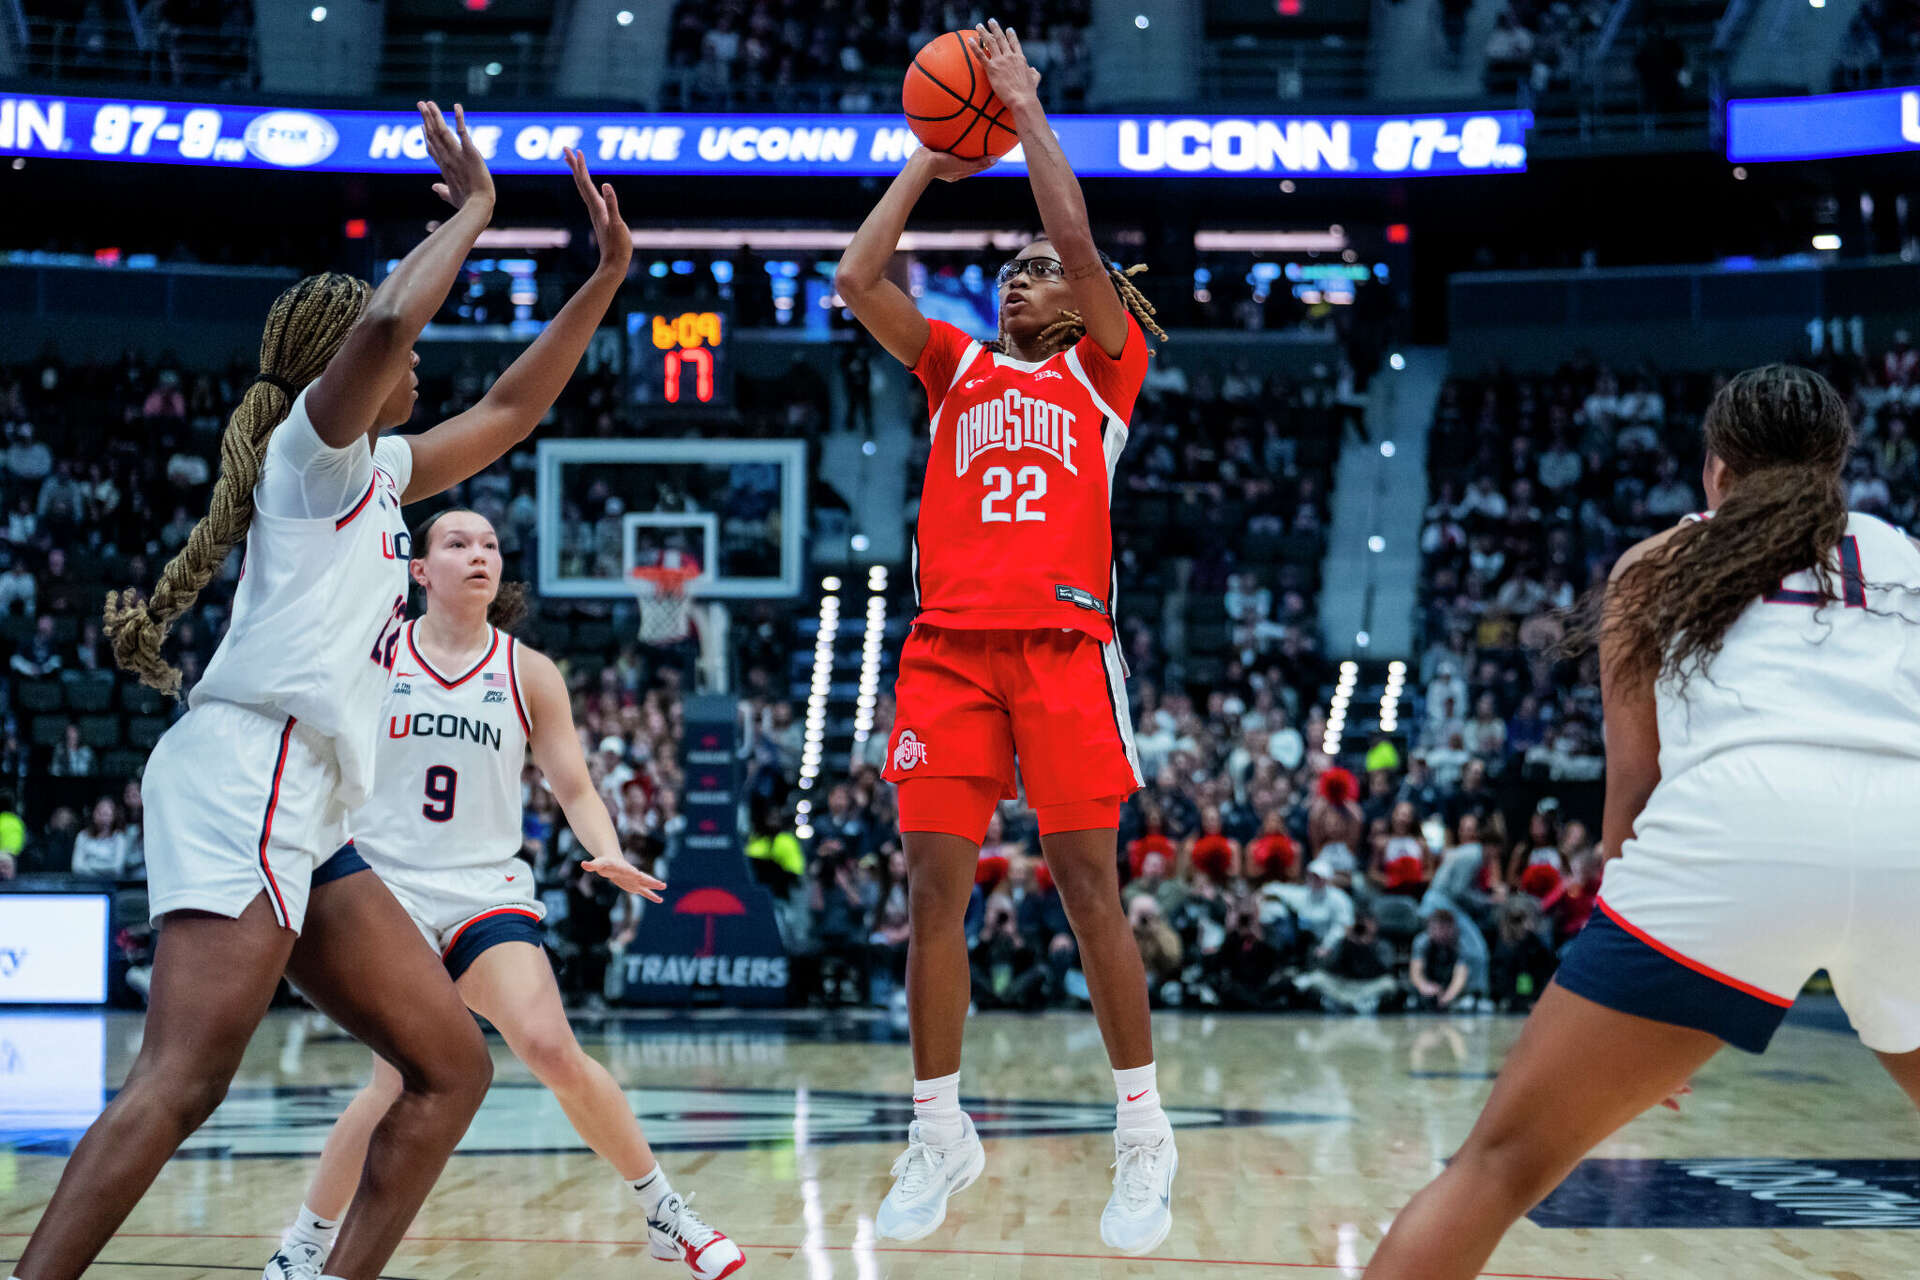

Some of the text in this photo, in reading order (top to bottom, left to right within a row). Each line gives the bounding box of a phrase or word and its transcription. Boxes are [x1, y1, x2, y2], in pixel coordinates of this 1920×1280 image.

[515, 125, 583, 160] OF
[597, 126, 685, 161] THE
[698, 127, 858, 162] UCONN
[1118, 119, 1351, 172] UCONN
[664, 346, 714, 403] 17
[981, 465, 1047, 523] 22
[389, 712, 502, 752] UCONN
[422, 764, 458, 823] 9
[626, 956, 789, 988] TRAVELERS
